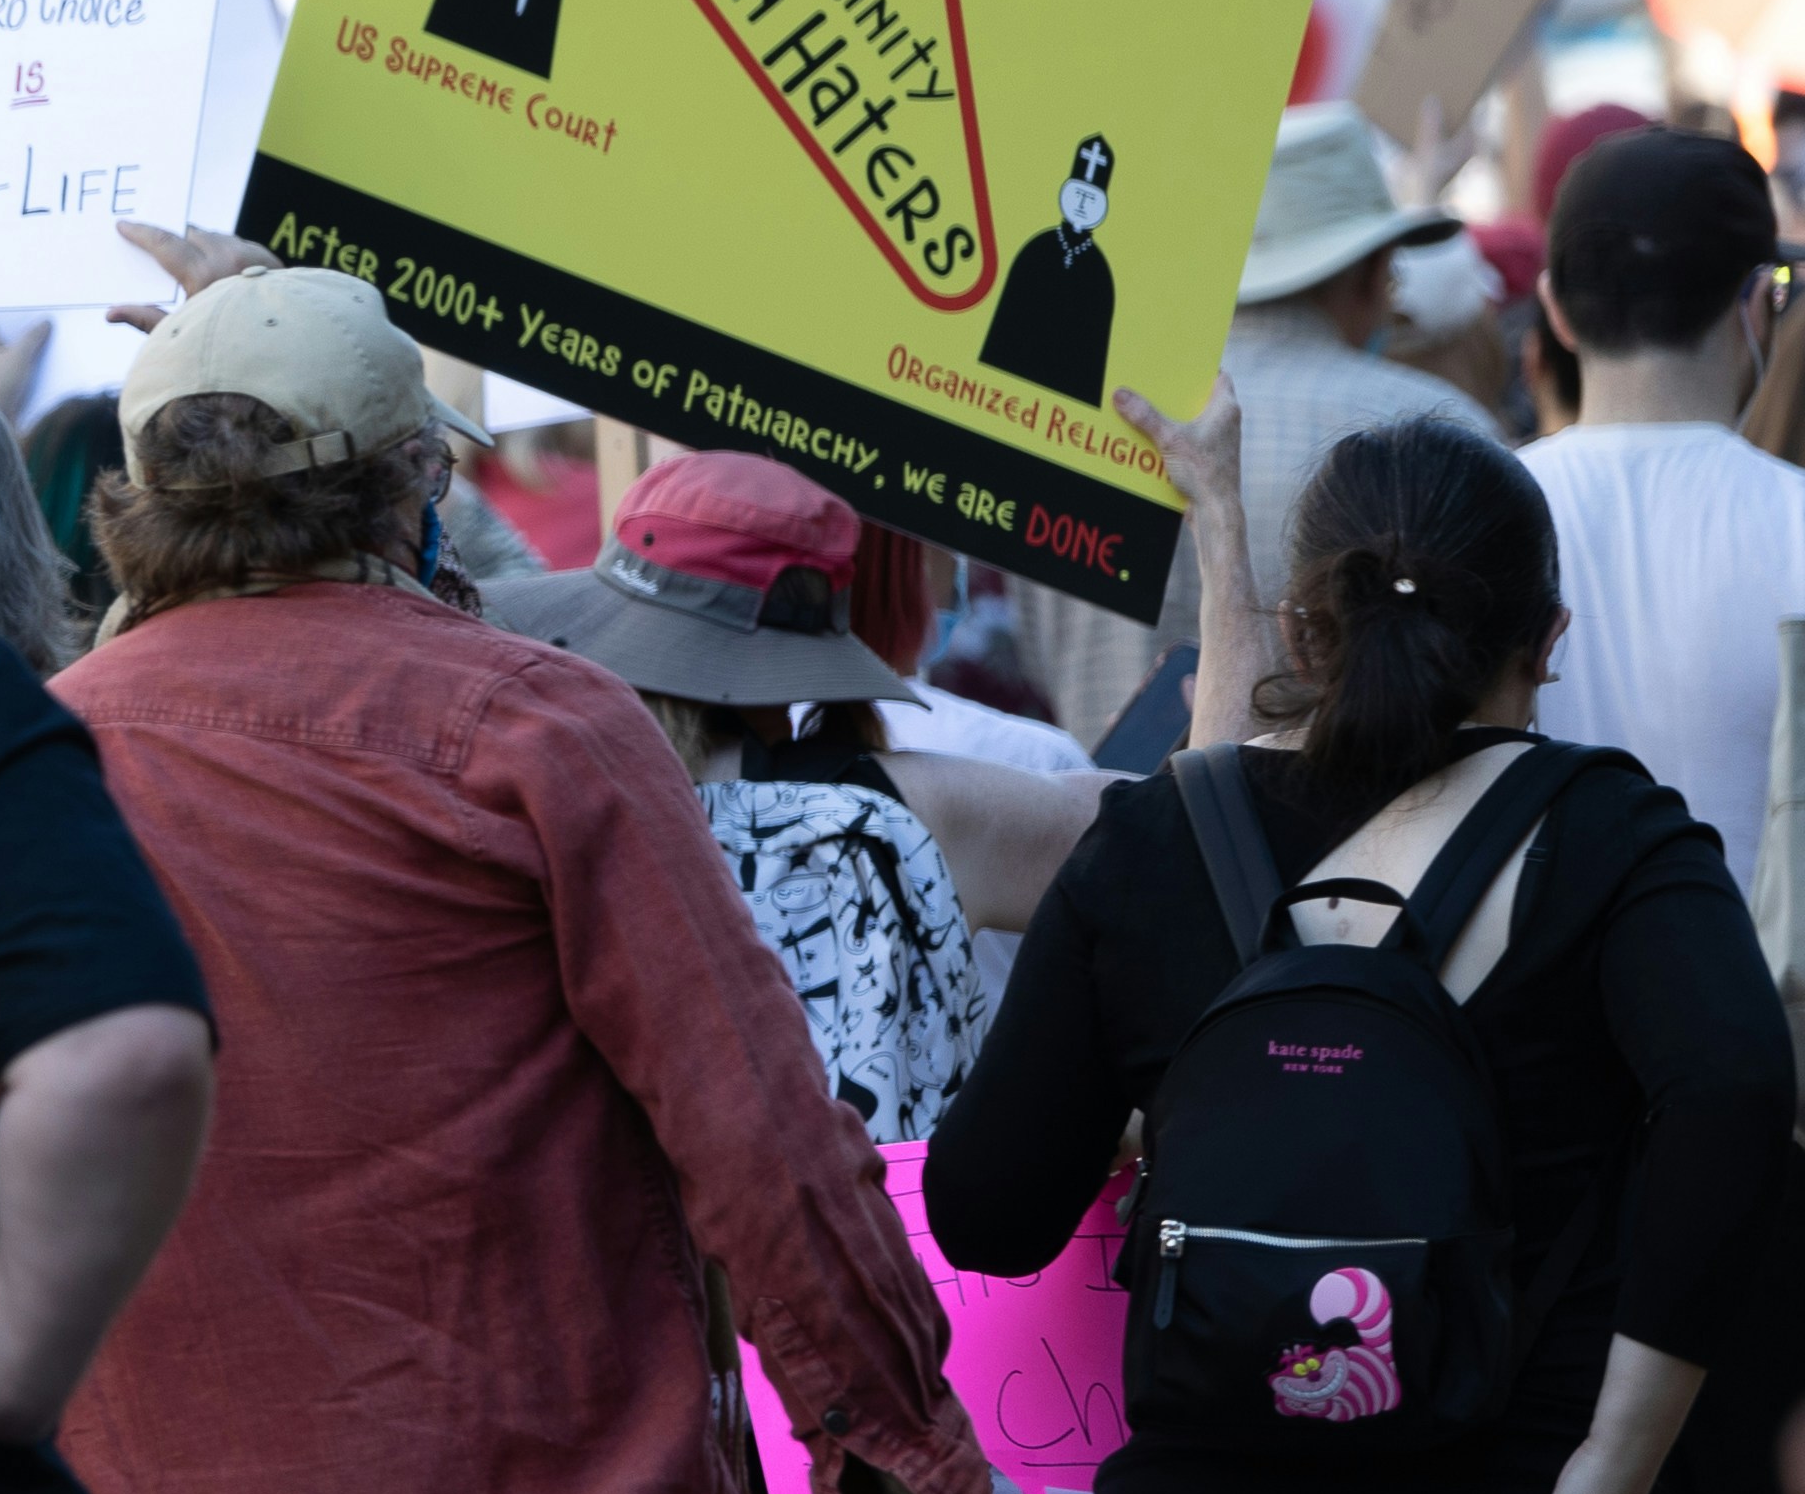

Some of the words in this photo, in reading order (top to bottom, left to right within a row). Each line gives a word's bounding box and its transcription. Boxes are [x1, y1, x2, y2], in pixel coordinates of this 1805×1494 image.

[337, 16, 378, 62] US
[387, 258, 503, 330] 2000+
[1268, 1040, 1306, 1058] kate
[1310, 1042, 1364, 1062] spade
[1283, 1062, 1309, 1073] NEW
[1312, 1063, 1344, 1075] YORK
